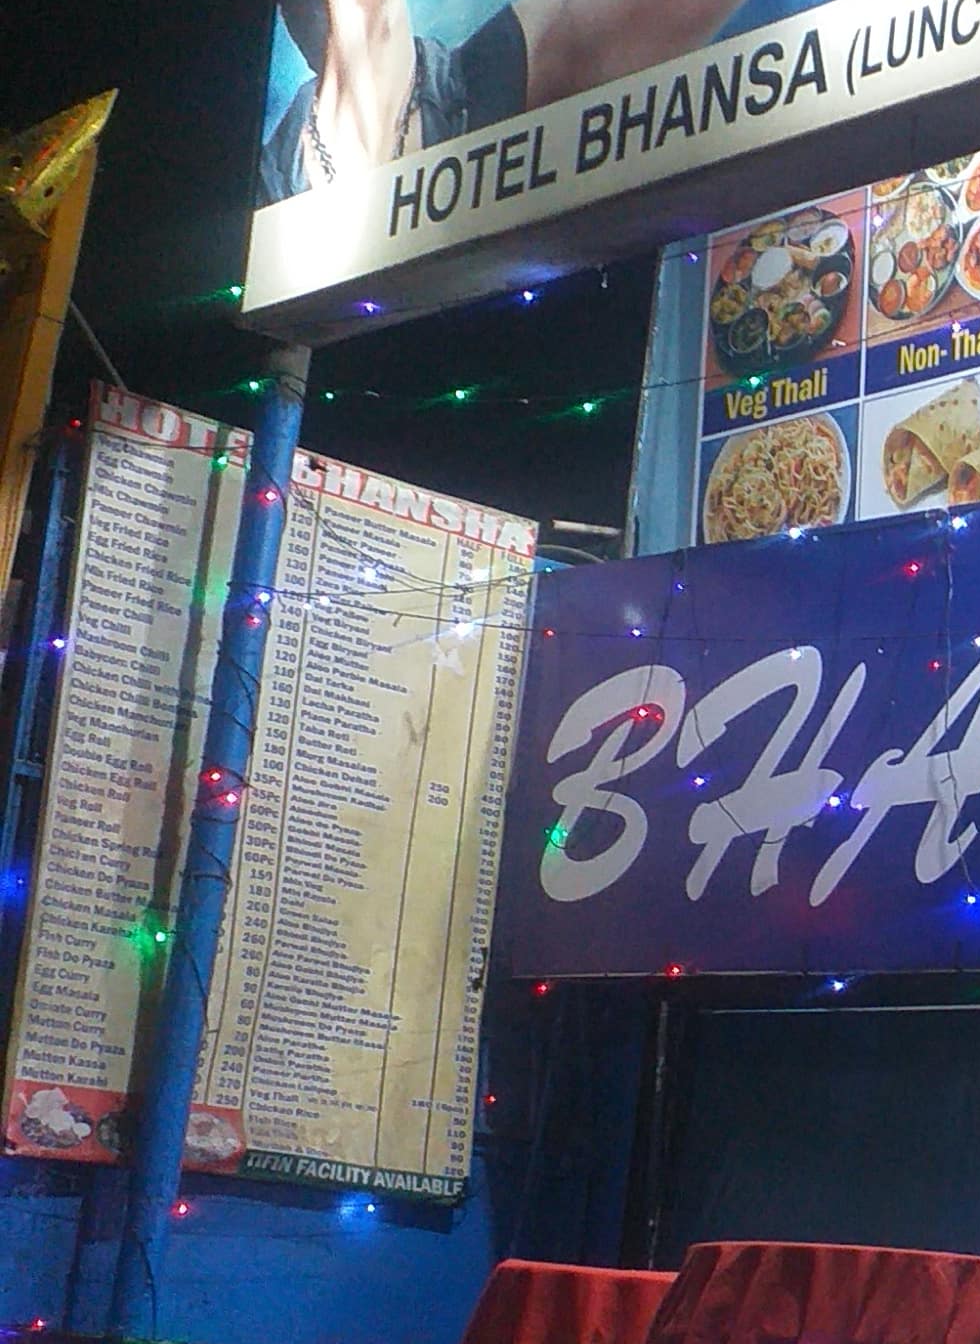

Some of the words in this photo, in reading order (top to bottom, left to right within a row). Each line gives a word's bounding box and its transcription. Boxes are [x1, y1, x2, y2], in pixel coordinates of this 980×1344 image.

[387, 125, 557, 238] HOTEL
[576, 31, 827, 170] BHANSA
[725, 387, 768, 425] Veg
[772, 369, 828, 411] Thali
[96, 468, 141, 491] Chicken
[101, 391, 254, 466] HOTE
[292, 454, 536, 556] BHANSHA
[113, 522, 141, 540] Fried
[144, 532, 168, 547] Rice
[111, 538, 140, 557] Fried
[86, 548, 132, 569] Chicken
[73, 661, 119, 682] Chicken
[69, 694, 115, 715] Chicken
[52, 828, 98, 848] Chicken
[47, 861, 95, 879] Chicken
[63, 952, 78, 963] Do
[296, 1159, 371, 1185] FACILITY
[373, 1172, 465, 1197] AVAILABLE
